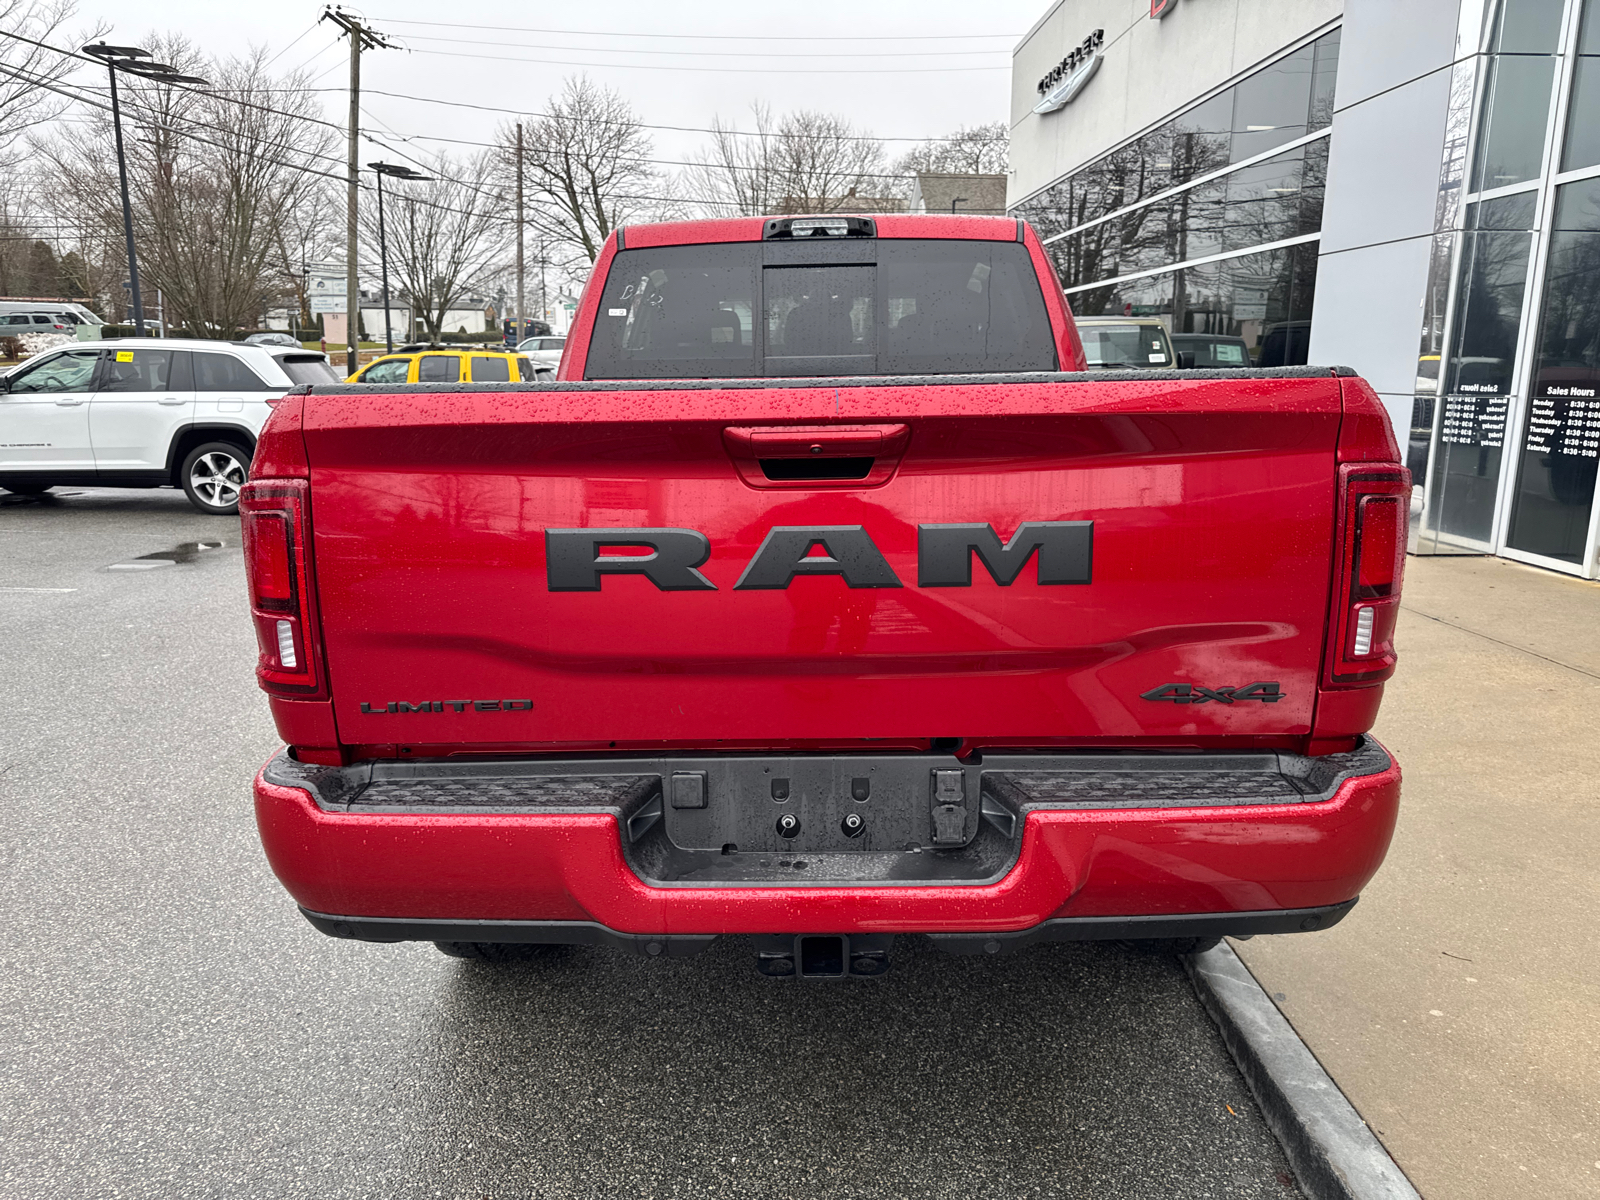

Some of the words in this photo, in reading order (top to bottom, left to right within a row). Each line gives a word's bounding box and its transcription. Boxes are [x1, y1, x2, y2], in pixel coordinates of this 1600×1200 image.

[1037, 28, 1104, 95] CHRYSLER
[1547, 386, 1569, 396] Sales
[1570, 387, 1595, 397] Hours
[1533, 399, 1555, 408] Monday
[1532, 408, 1555, 417] Tuesday
[1531, 417, 1561, 427] Wednesday
[1530, 426, 1555, 435] Thursday
[1528, 434, 1545, 444] Friday
[1527, 443, 1551, 454] Saturday
[545, 520, 1094, 592] RAM
[360, 699, 534, 714] LIMITED
